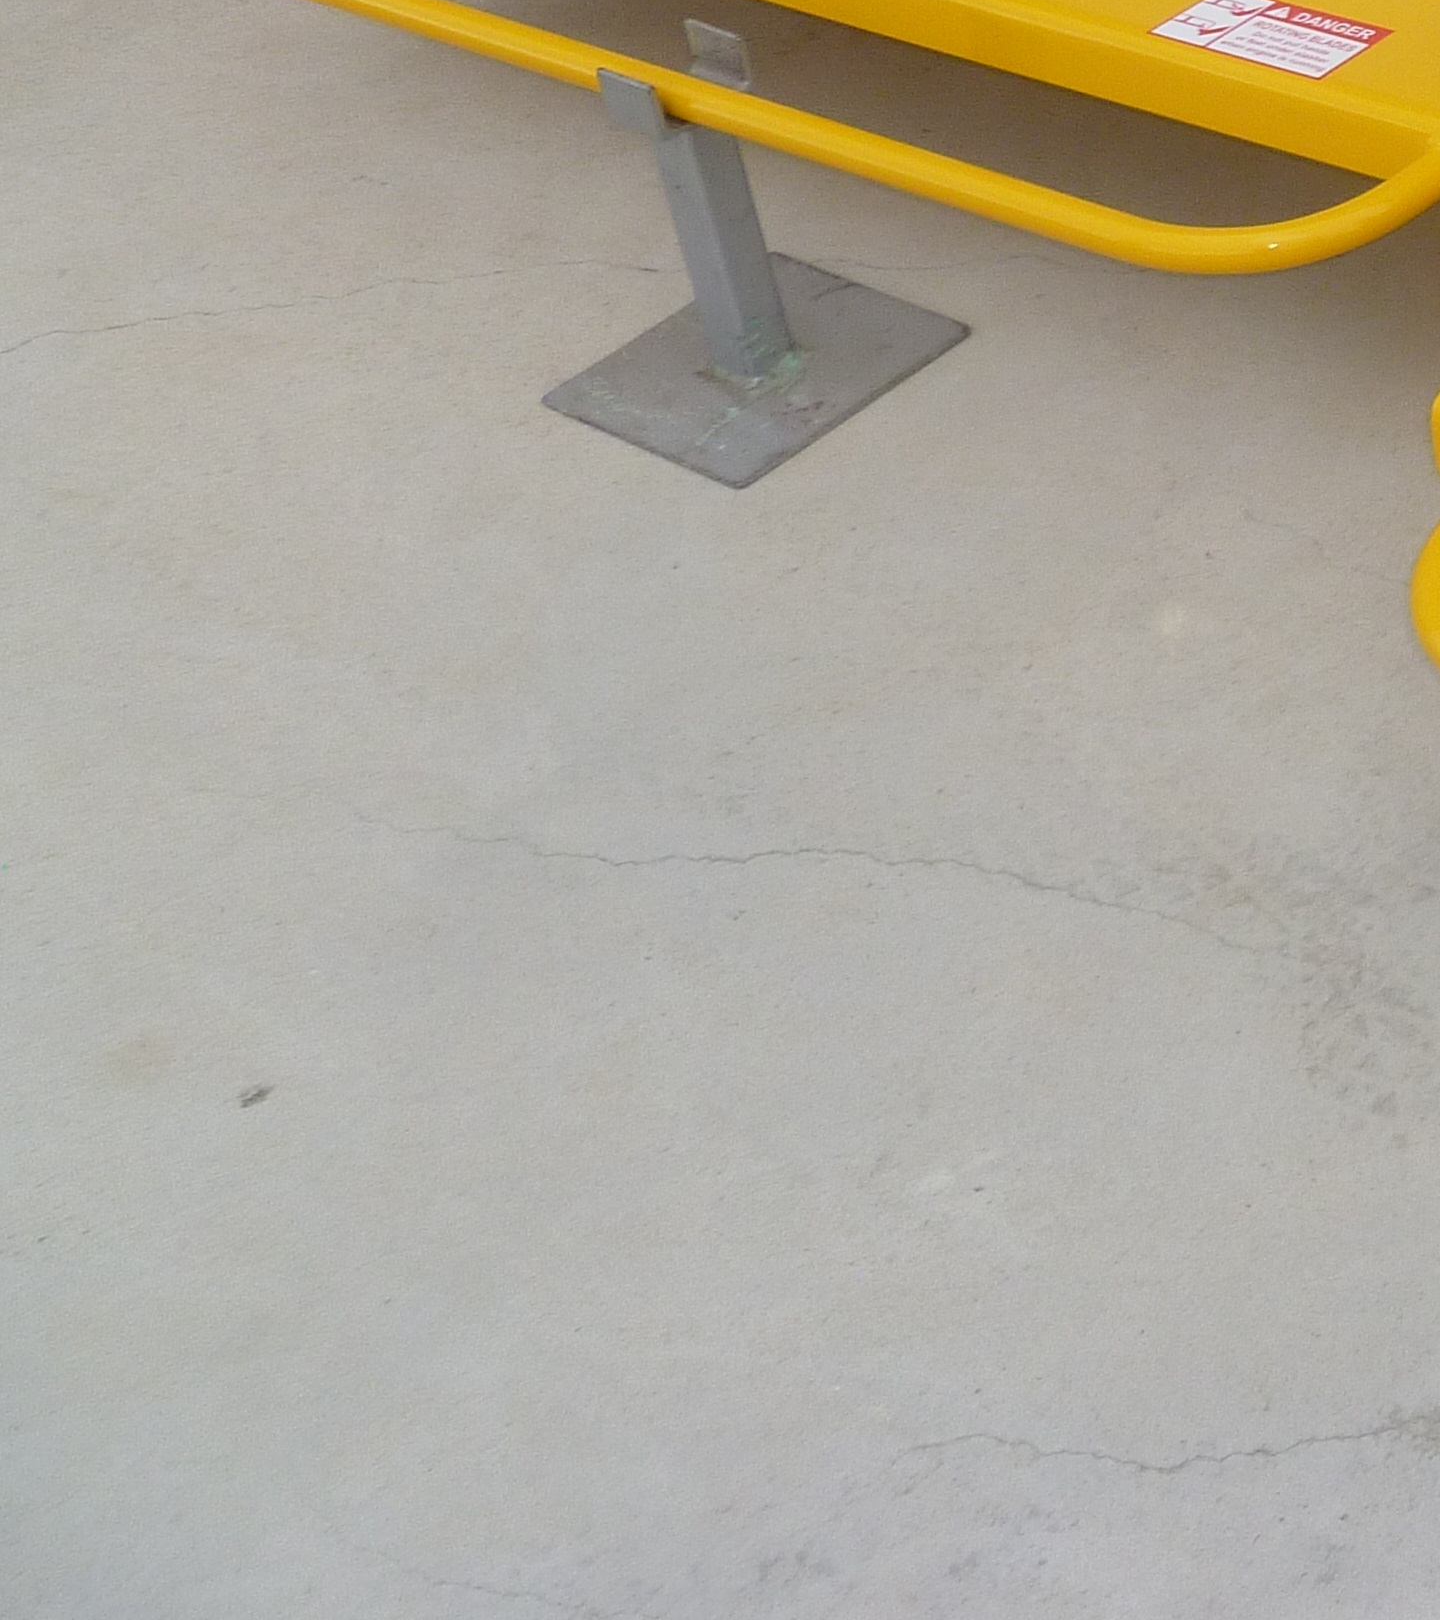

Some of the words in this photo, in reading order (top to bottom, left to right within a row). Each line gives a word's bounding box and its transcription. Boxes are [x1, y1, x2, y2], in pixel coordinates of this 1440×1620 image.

[1253, 20, 1310, 40] ROTATING
[1308, 36, 1358, 53] BLADES
[1291, 12, 1376, 40] DANGER
